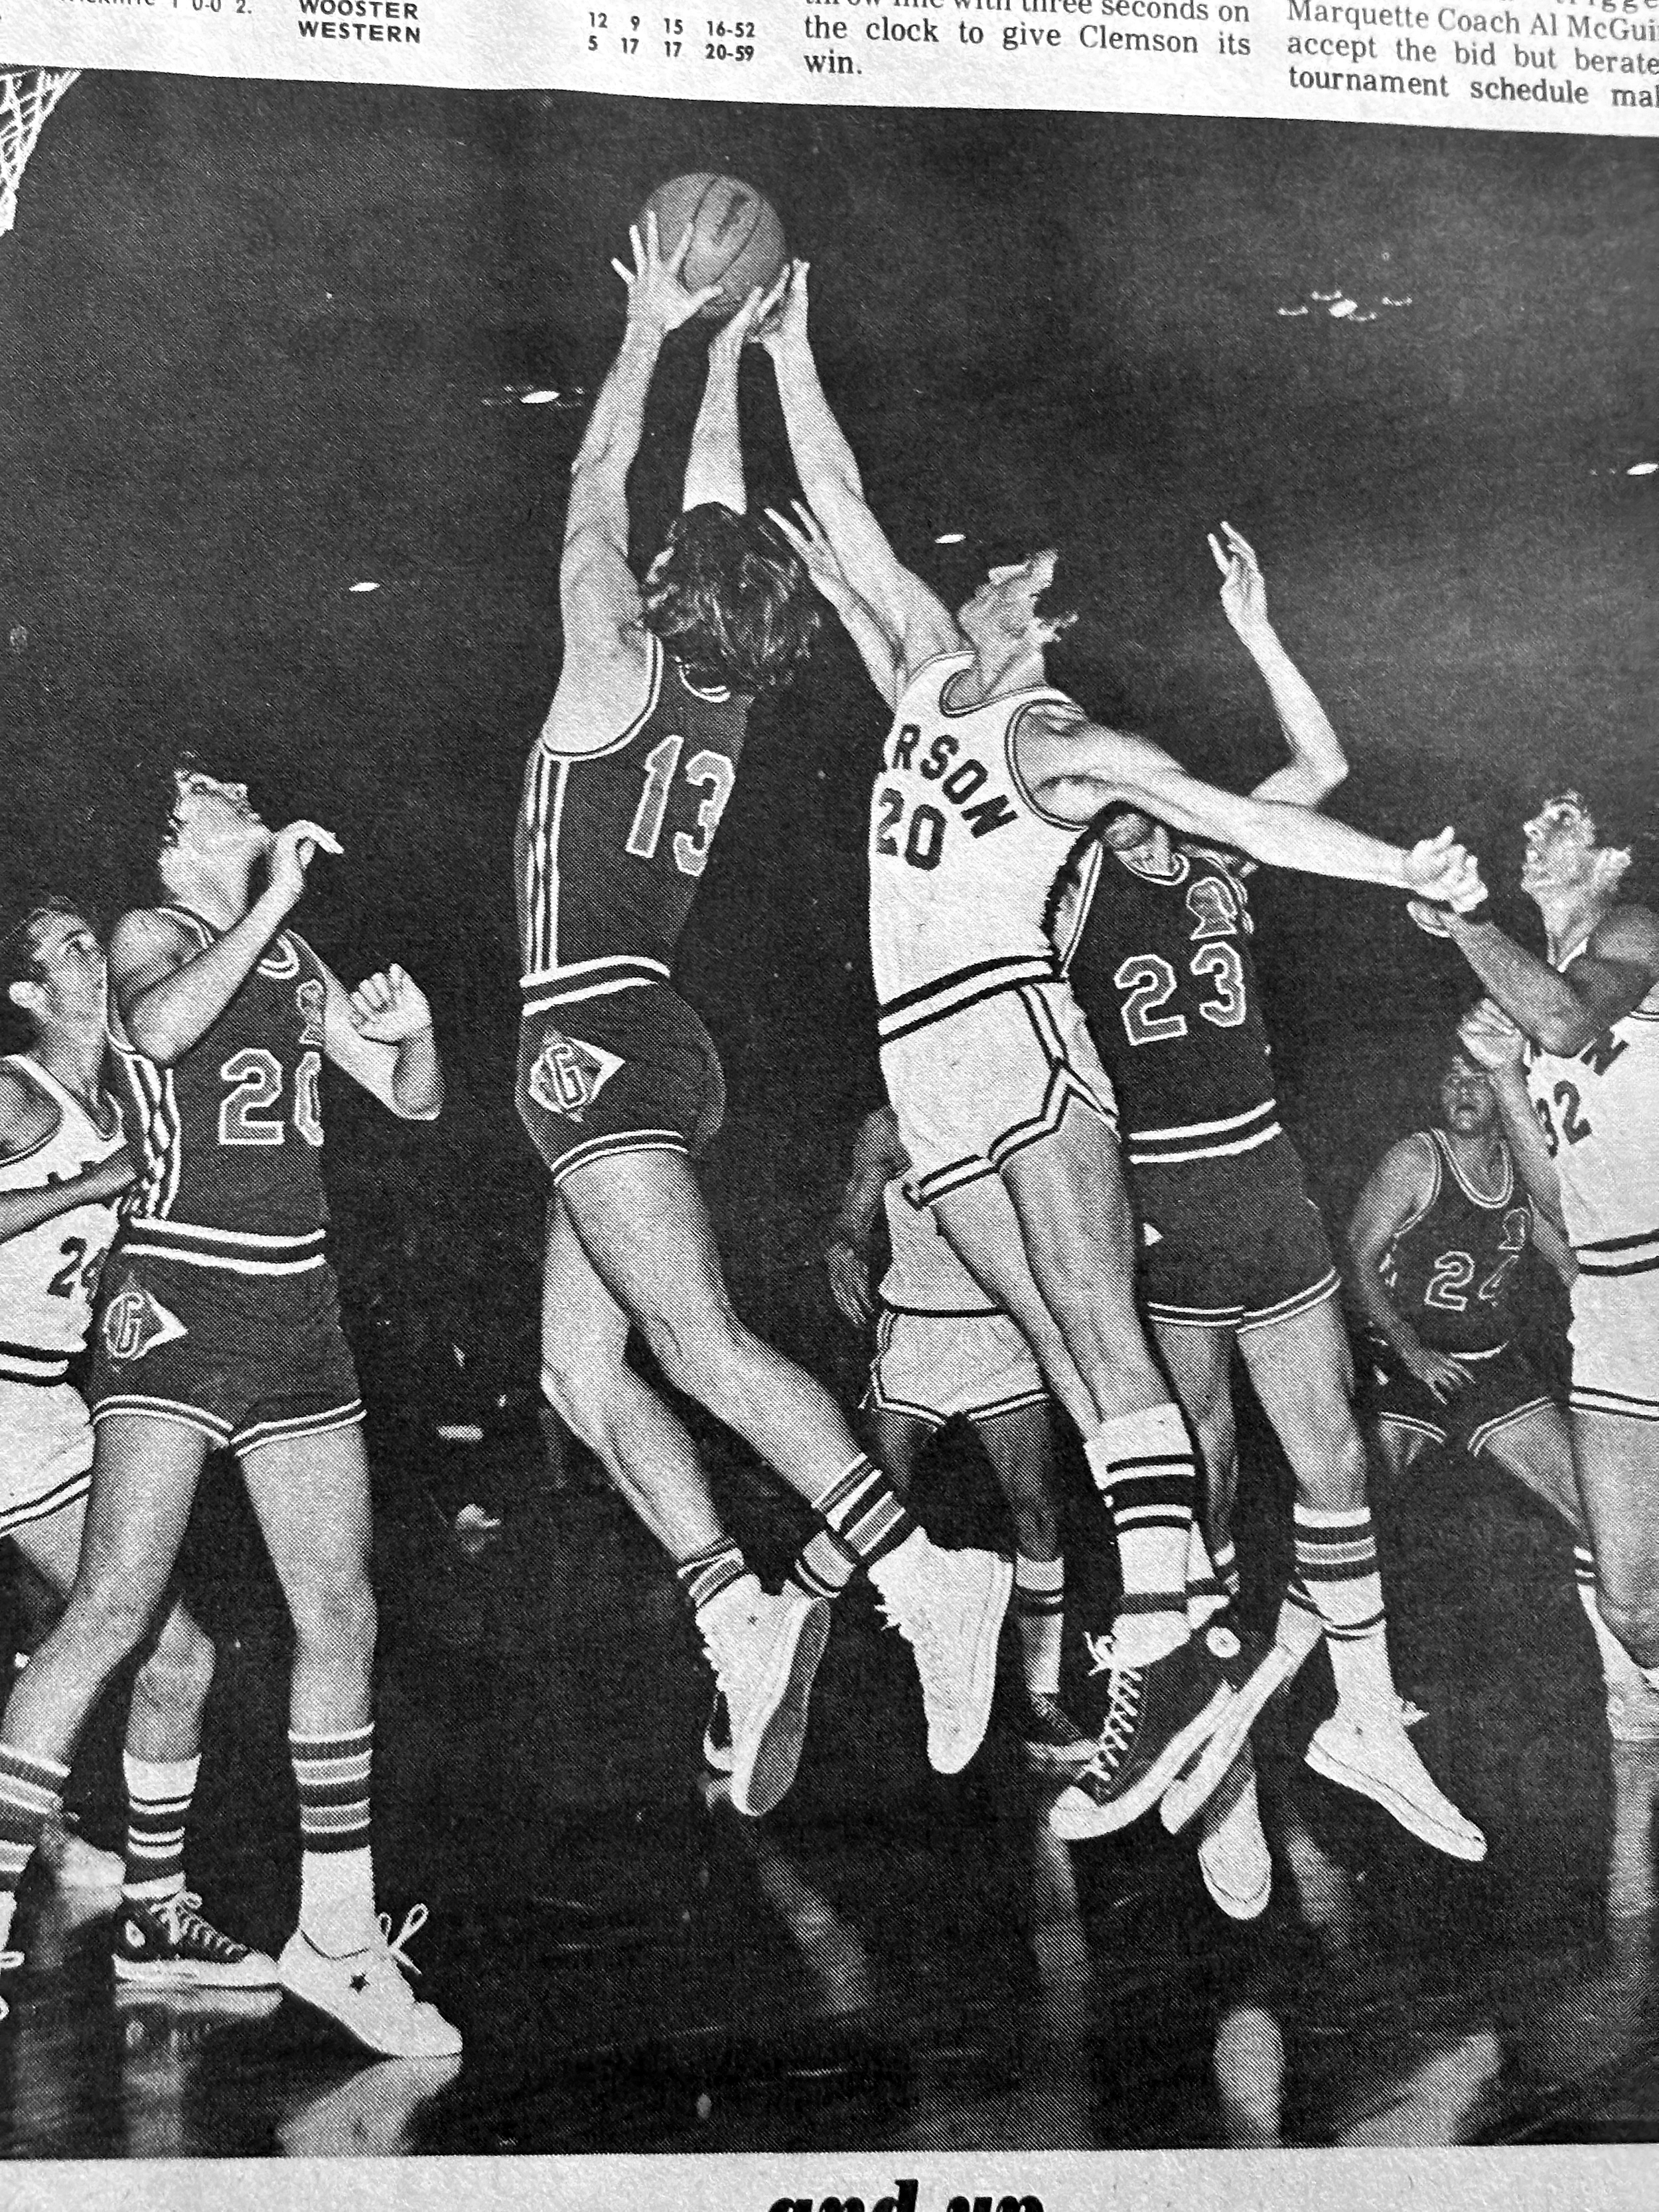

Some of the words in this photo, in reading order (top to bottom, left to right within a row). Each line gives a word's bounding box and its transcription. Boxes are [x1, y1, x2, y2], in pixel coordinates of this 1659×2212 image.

[299, 0, 418, 20] WOOSTER
[589, 11, 608, 29] 12
[630, 15, 640, 31] 9
[664, 17, 684, 35] 15
[707, 21, 755, 38] 16-52
[1102, 0, 1208, 20] seconds
[1218, 5, 1250, 22] on
[1289, 0, 1429, 30] Marquette
[1438, 9, 1520, 33] Coach
[1531, 13, 1557, 36] Al
[1568, 15, 1659, 41] McGui
[298, 20, 421, 44] WESTERN
[588, 35, 598, 51] 5
[621, 37, 639, 54] 17
[664, 40, 682, 58] 17
[705, 42, 755, 62] 20-59
[804, 15, 847, 39] the
[865, 16, 939, 42] clock
[959, 21, 984, 44] to
[1003, 21, 1061, 51] give
[1080, 25, 1198, 53] Clemson
[1218, 31, 1251, 55] its
[803, 48, 862, 75] win.
[1287, 37, 1375, 63] accept
[1396, 37, 1436, 62] the
[1455, 41, 1495, 65] bid
[1514, 44, 1556, 69] but
[1575, 47, 1659, 75] berate
[1289, 66, 1449, 97] tournament
[1471, 76, 1588, 104] schedule
[625, 735, 735, 877] 13
[876, 788, 947, 871] 20
[1114, 941, 1246, 1046] 23
